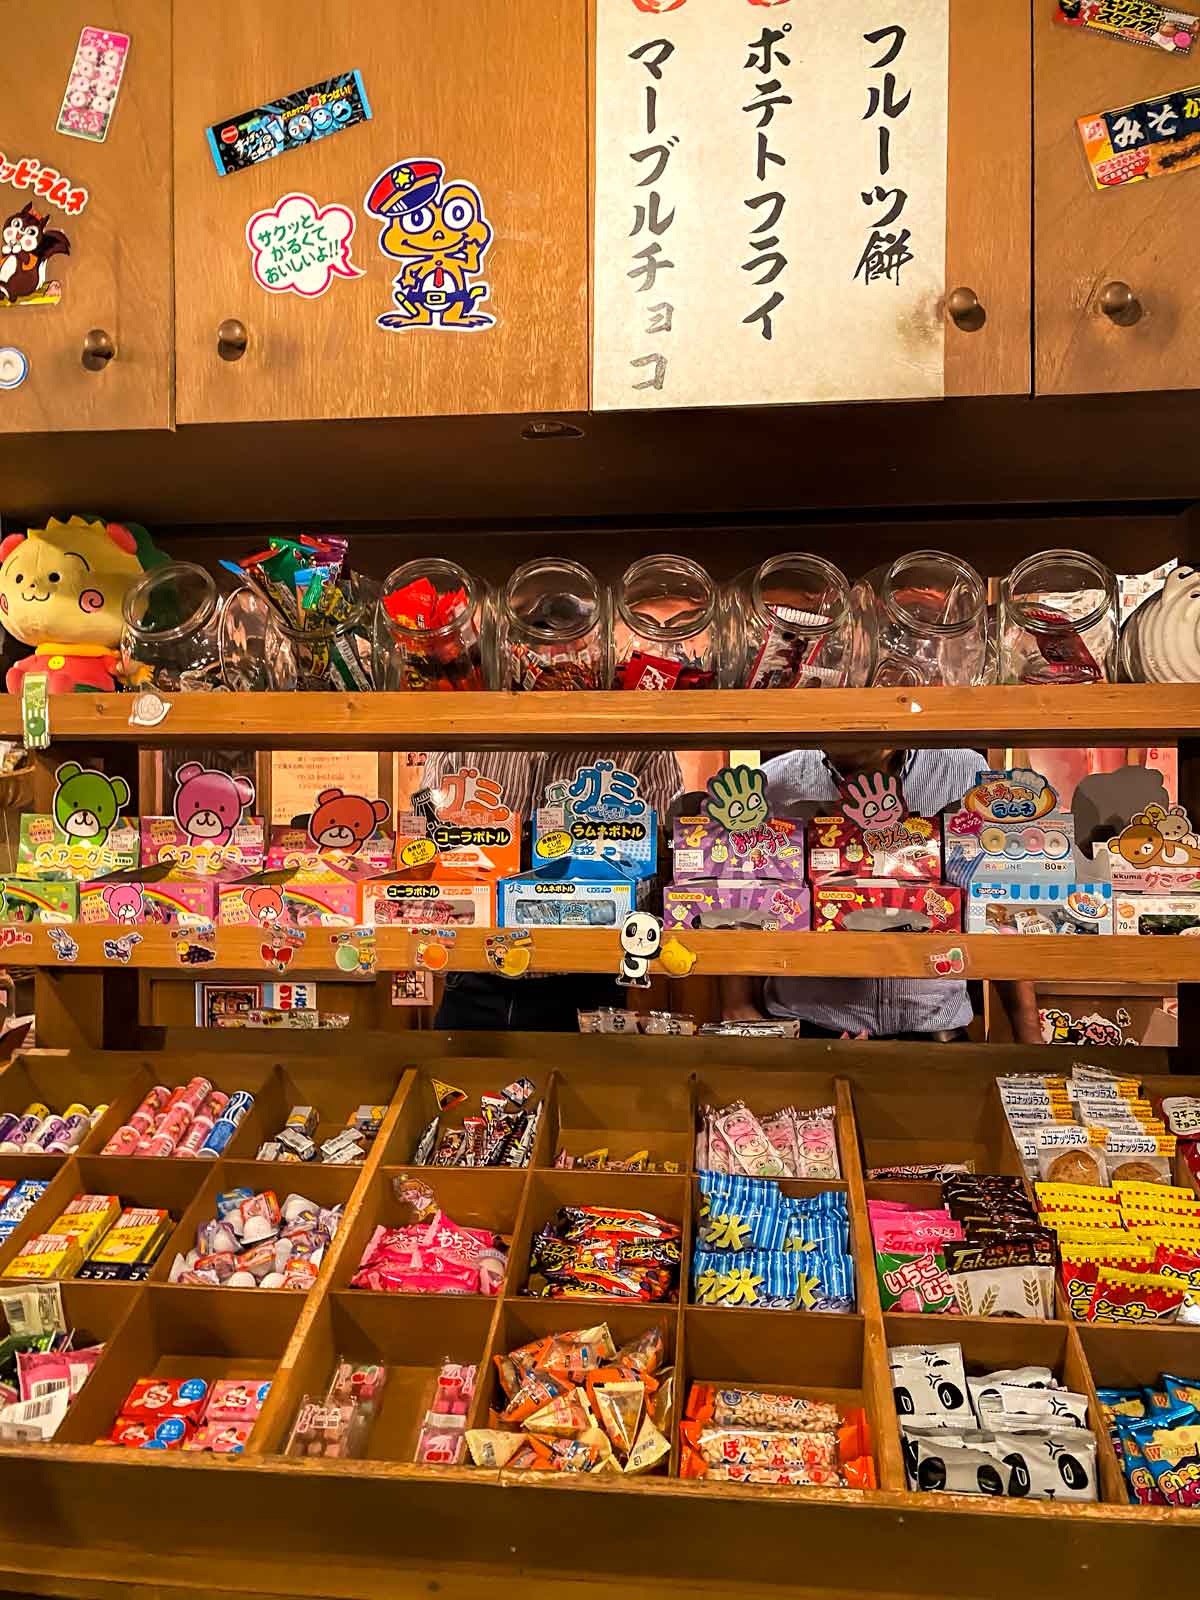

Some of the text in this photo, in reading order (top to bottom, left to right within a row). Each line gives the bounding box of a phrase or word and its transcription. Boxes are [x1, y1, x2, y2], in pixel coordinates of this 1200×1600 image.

[853, 24, 914, 286] フルーツ餅
[0, 156, 86, 213] ッピーラムネ
[741, 21, 793, 342] ポテトフライ
[627, 37, 680, 392] マーブルチョコ
[258, 214, 315, 247] サクッと
[270, 226, 328, 264] かるくて
[568, 761, 646, 815] グミ
[993, 802, 1034, 815] ラムネ
[437, 831, 509, 844] コーラボトル
[573, 825, 643, 838] ラムネボトル
[40, 849, 113, 864] ベアーグミ
[389, 886, 439, 897] コーラボトル
[536, 885, 575, 893] ラムネボトル
[1005, 1095, 1050, 1105] ココナッツラスク
[1040, 1134, 1088, 1145] ココナッツラスク
[1106, 1143, 1156, 1153] ココナッツラスク
[437, 1228, 480, 1250] もちっと
[952, 1248, 1031, 1272] Takaoka
[1096, 1299, 1159, 1320] シュガー
